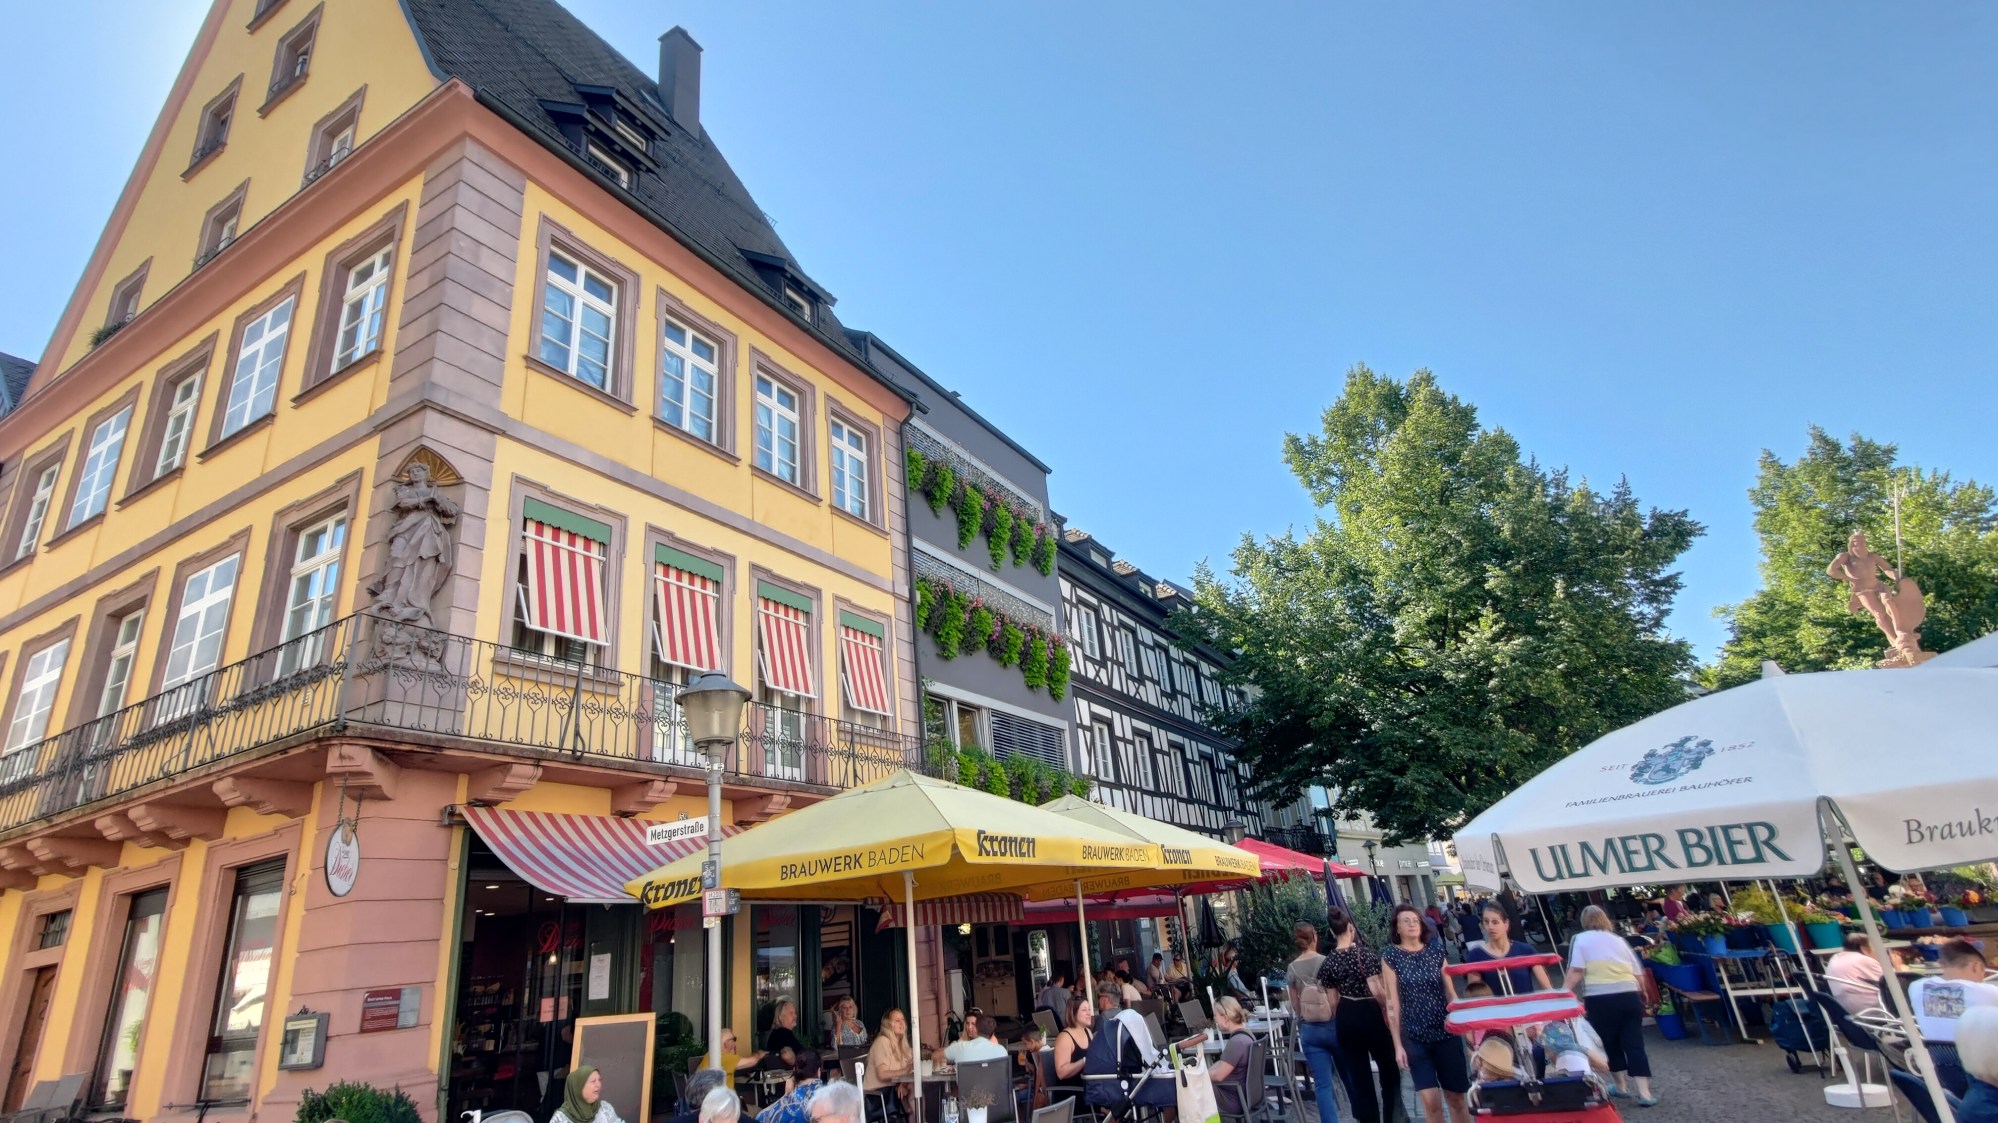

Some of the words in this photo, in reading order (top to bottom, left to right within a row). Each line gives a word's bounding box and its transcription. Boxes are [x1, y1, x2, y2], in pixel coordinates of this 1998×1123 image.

[1600, 763, 1628, 772] SEIT
[1720, 741, 1756, 753] 1852
[1565, 787, 1676, 808] FAMILIENBRAUEREI
[1679, 776, 1753, 792] BAUHÖFER
[650, 821, 704, 841] Metzgerstraße
[1903, 808, 1998, 845] Brauk
[780, 852, 863, 880] BRAUWERK
[868, 843, 925, 868] BADEN
[1082, 845, 1125, 861] BRAUWERK
[1125, 847, 1150, 862] BADEN
[1528, 832, 1682, 882] ULMER
[1675, 821, 1796, 869] BIER
